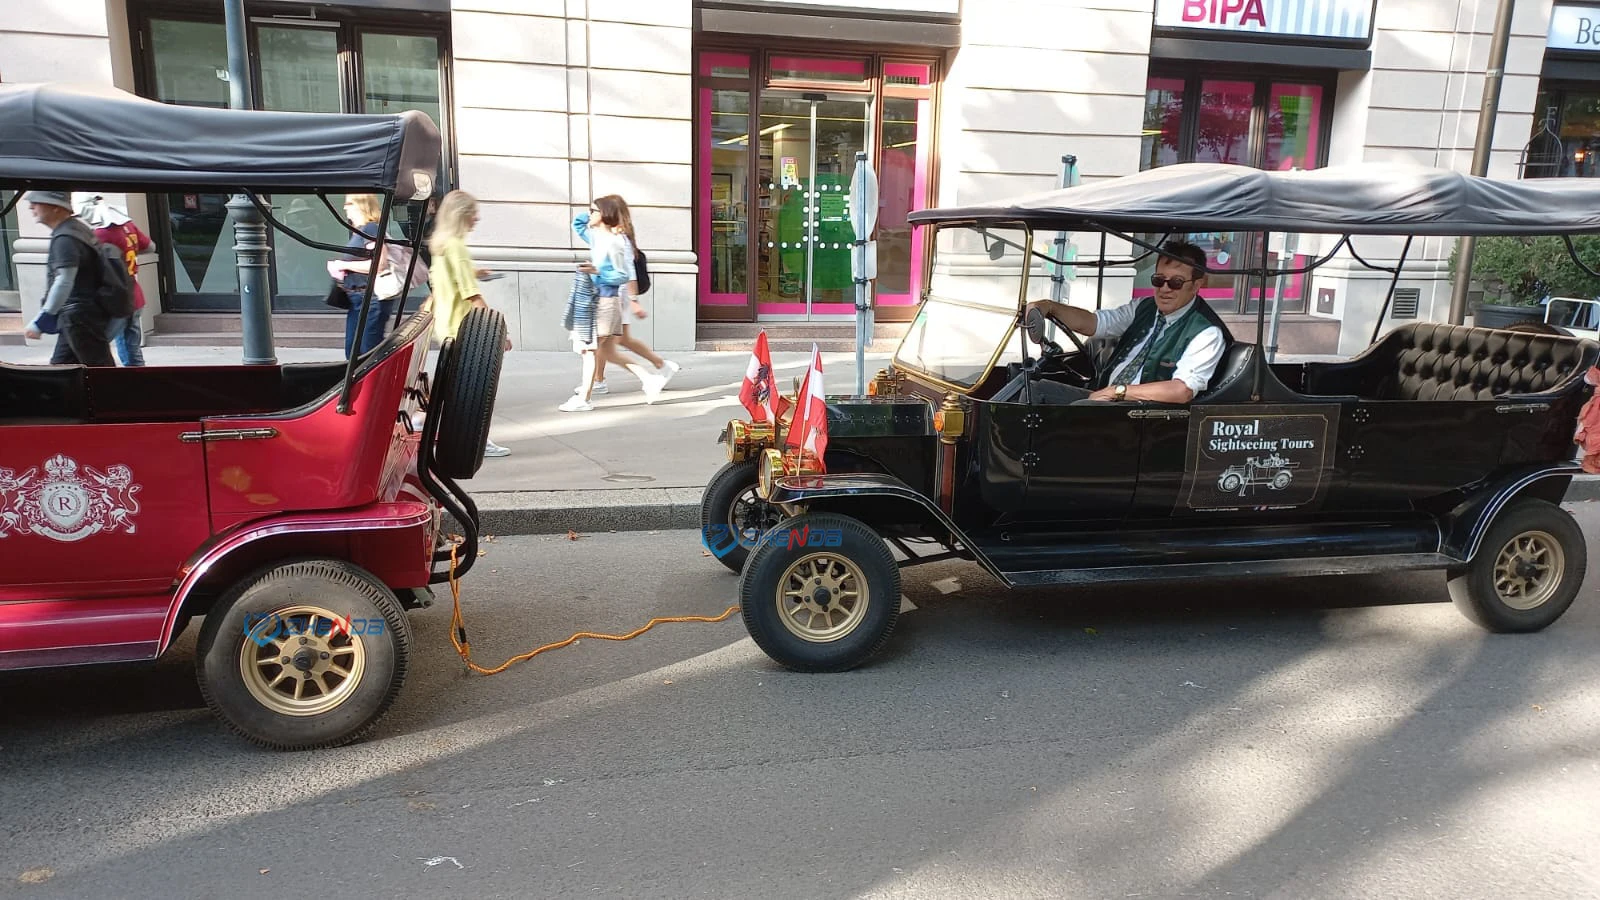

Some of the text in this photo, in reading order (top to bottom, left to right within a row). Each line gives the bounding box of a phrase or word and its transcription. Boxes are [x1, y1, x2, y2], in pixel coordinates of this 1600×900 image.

[1182, 0, 1266, 27] BIPA
[1213, 420, 1259, 438] Royal
[1209, 438, 1315, 453] Sightseeing Tours
[59, 497, 72, 510] R
